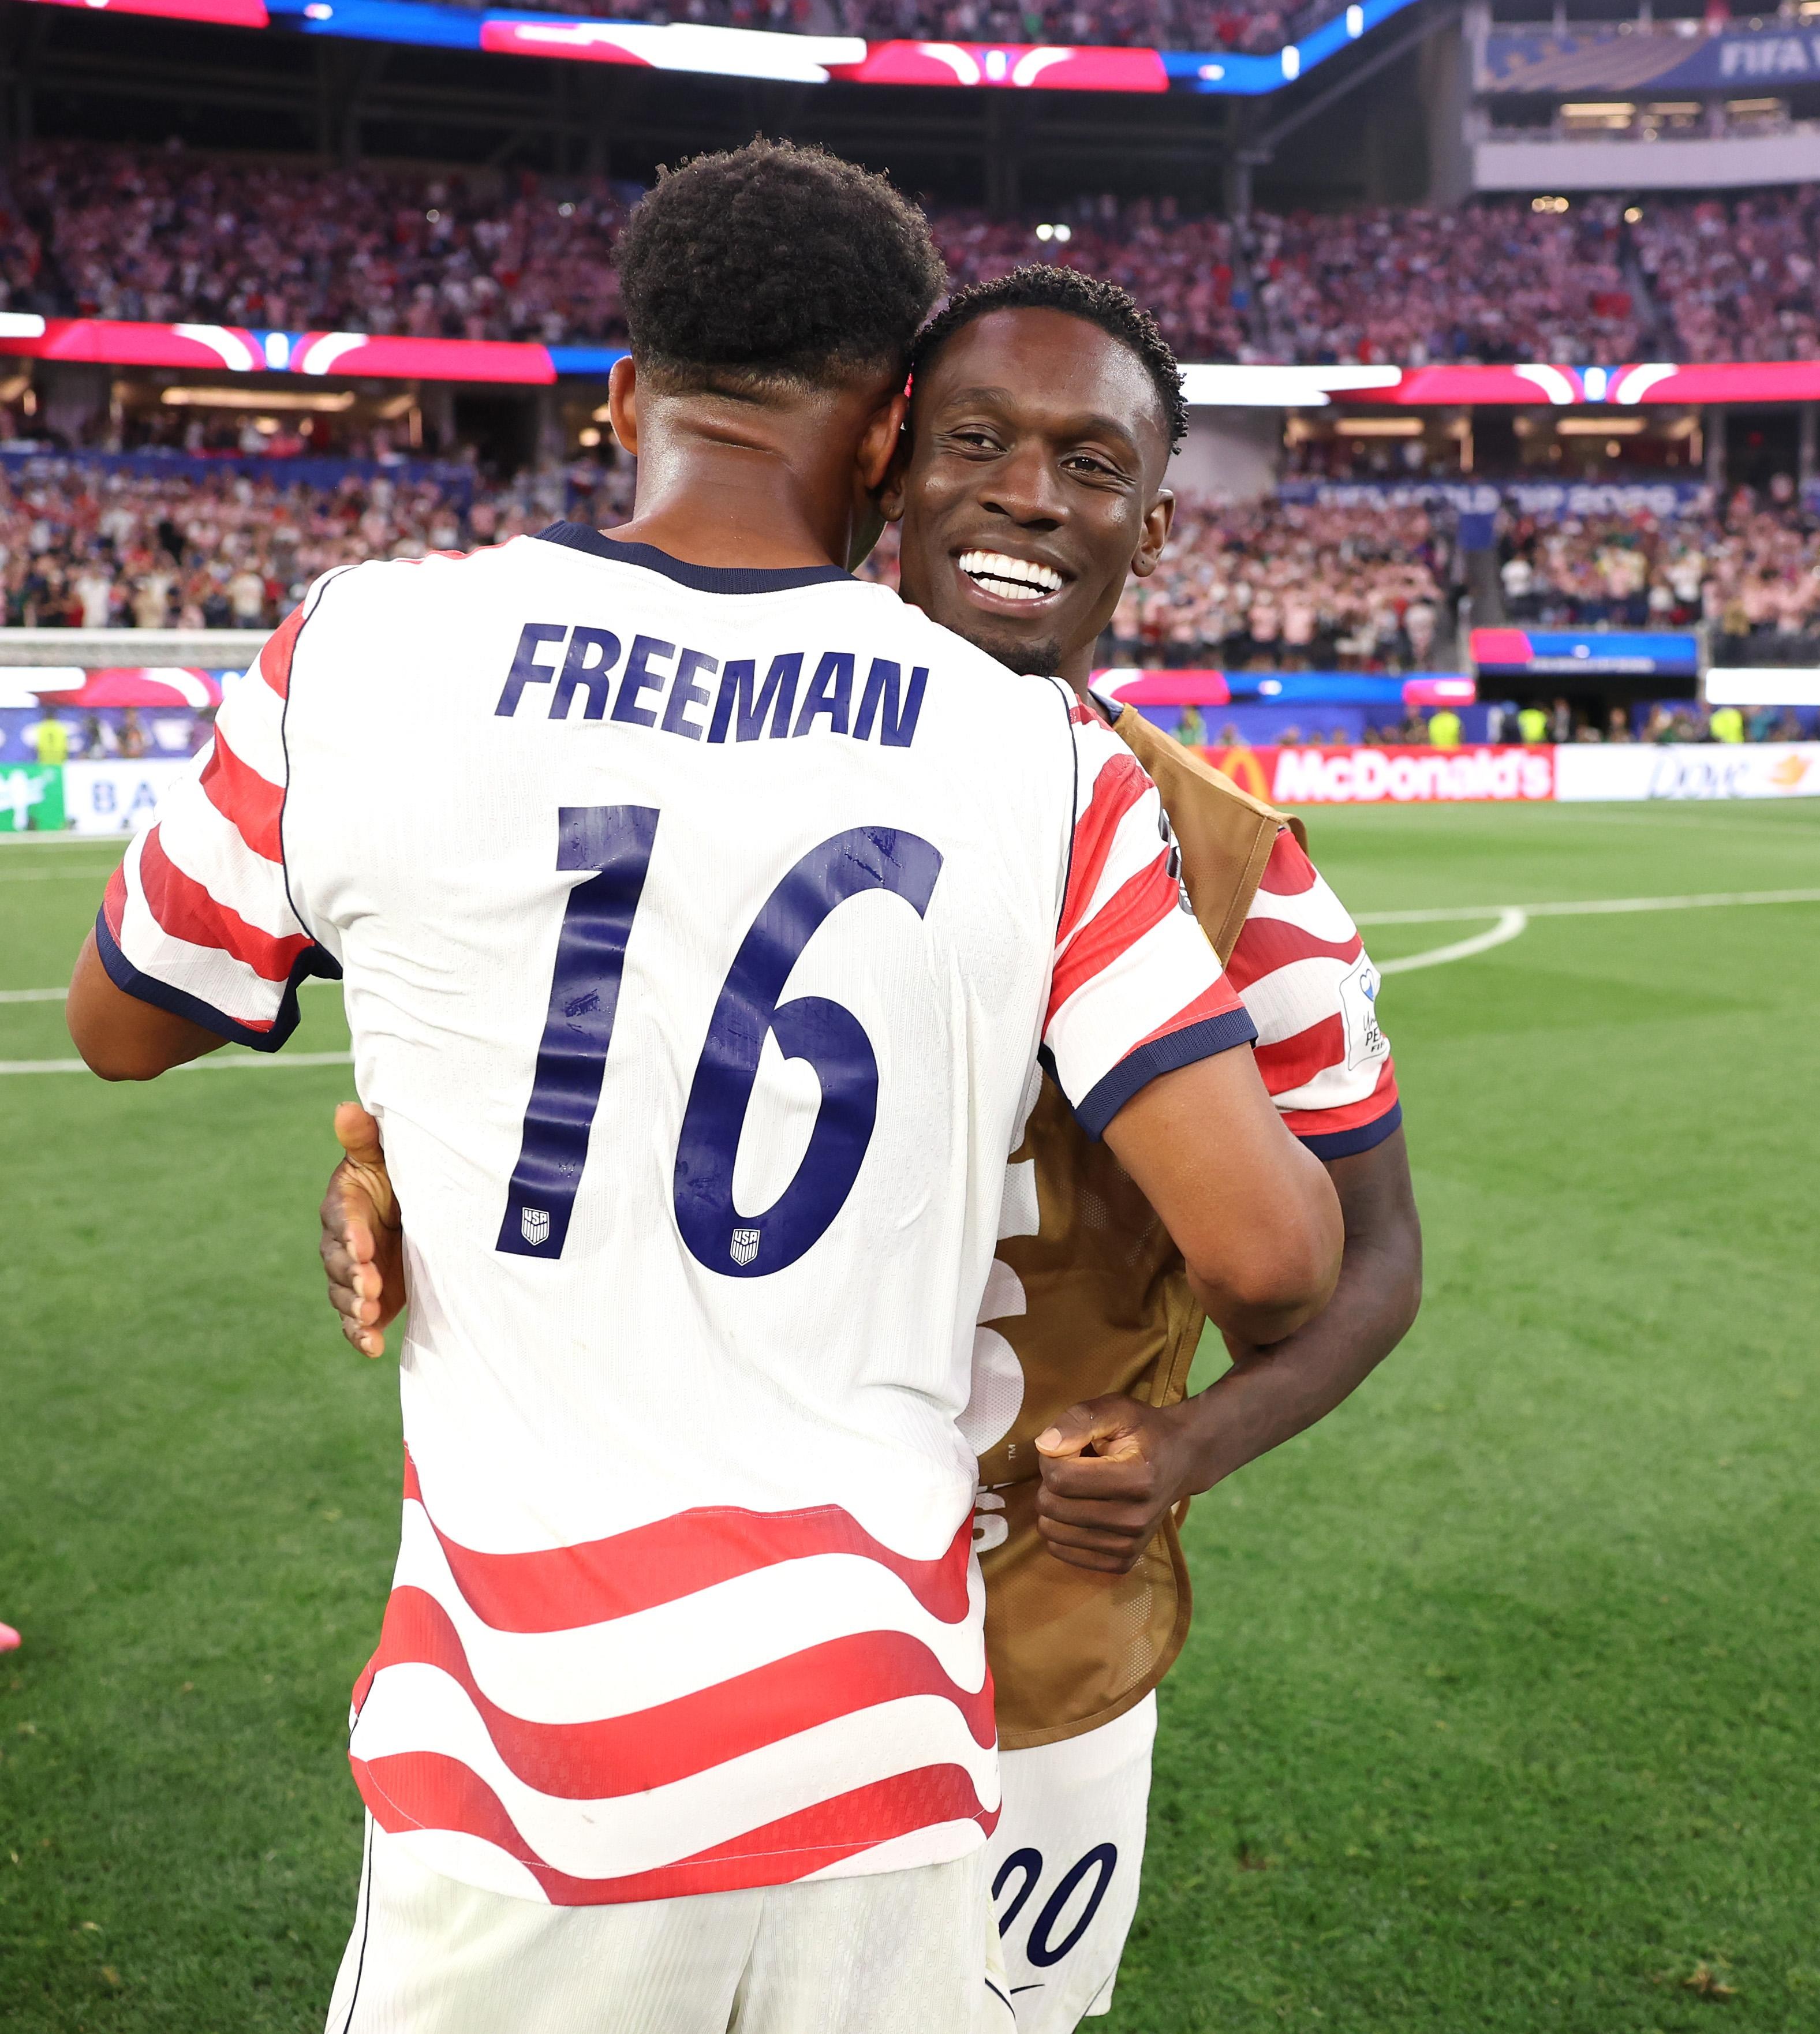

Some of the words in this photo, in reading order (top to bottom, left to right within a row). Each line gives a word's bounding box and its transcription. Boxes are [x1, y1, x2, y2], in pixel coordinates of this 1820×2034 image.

[1719, 38, 1808, 76] FIFA
[495, 622, 929, 748] FREEMAN
[1273, 749, 1552, 802] McDonald's
[495, 805, 944, 1278] 16
[1365, 1026, 1382, 1046] PE
[524, 1210, 547, 1225] USA
[734, 1231, 758, 1246] USA
[1008, 1444, 1016, 1461] TM
[991, 1842, 1118, 1968] 20
